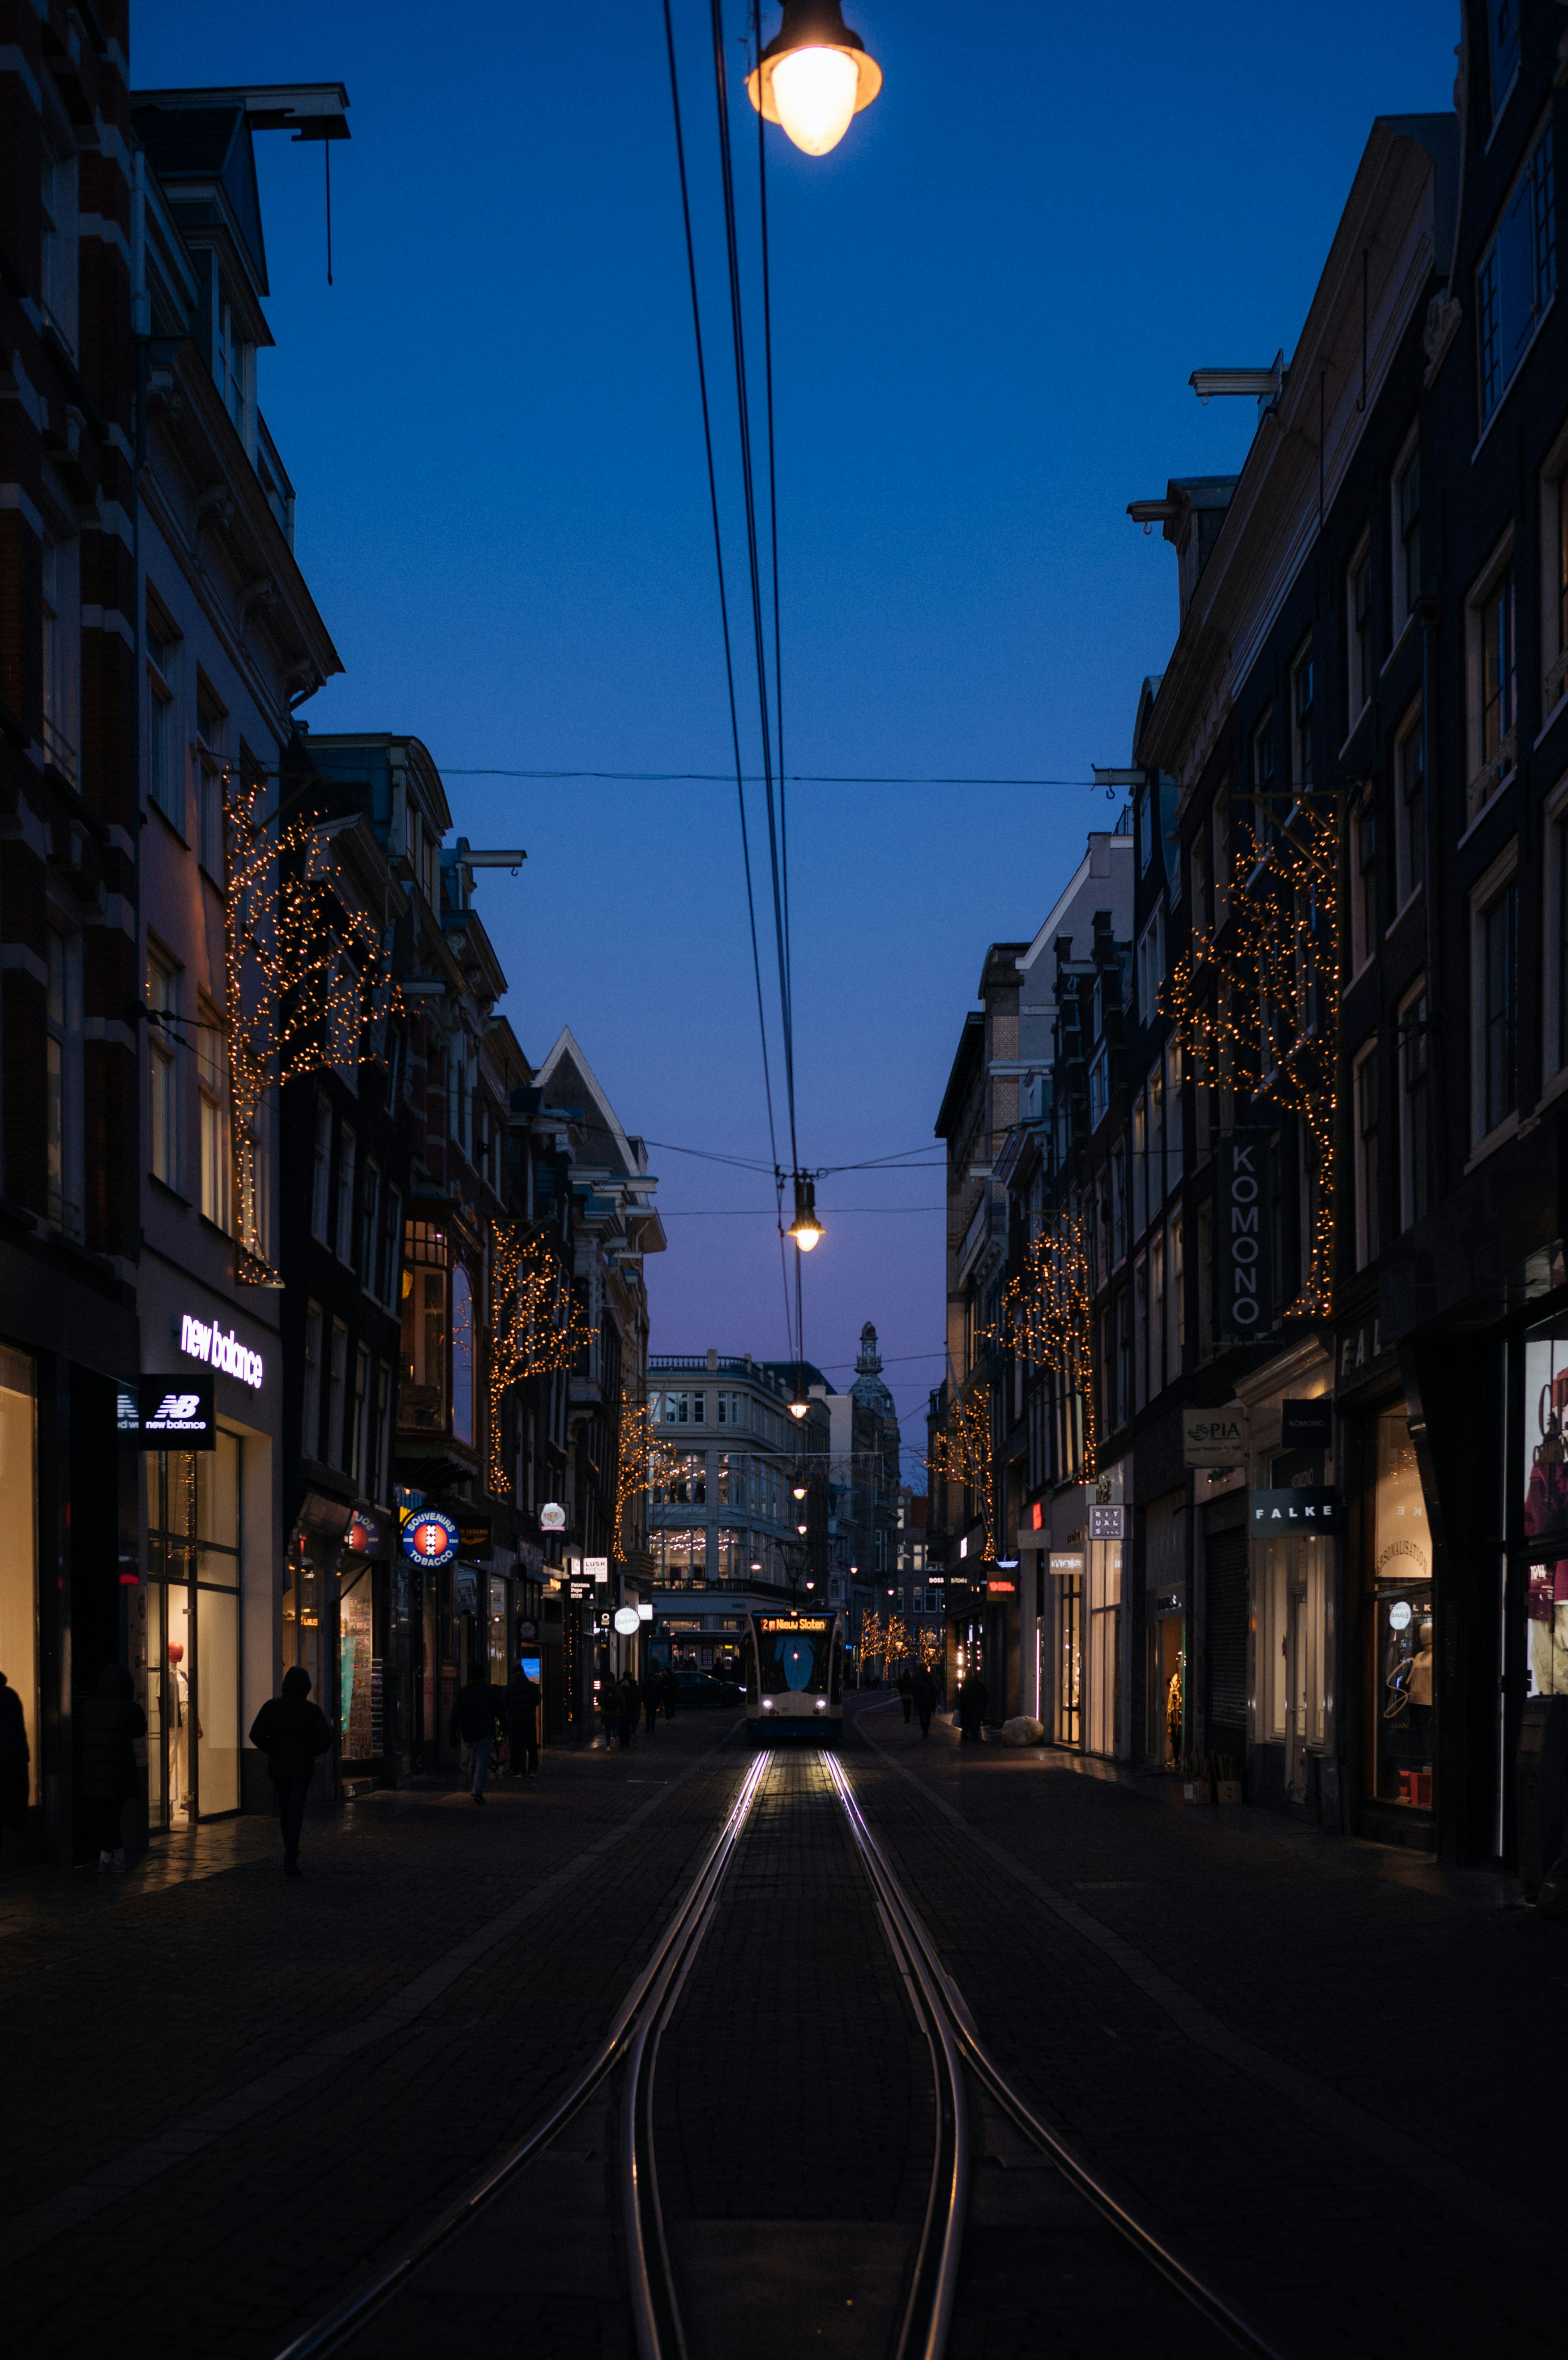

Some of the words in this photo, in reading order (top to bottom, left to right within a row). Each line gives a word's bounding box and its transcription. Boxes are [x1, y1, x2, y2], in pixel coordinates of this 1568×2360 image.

[1231, 1146, 1260, 1325] KOMONO
[181, 1314, 213, 1362] new
[211, 1320, 263, 1389] balance
[166, 1419, 207, 1429] balance
[1211, 1422, 1240, 1437] PIA
[1256, 1505, 1332, 1519] FALKE
[407, 1512, 456, 1533] SOUVENIRS
[410, 1549, 453, 1566] TOBACCO
[762, 1619, 768, 1629] 2
[776, 1618, 799, 1630] Nieuw
[799, 1618, 825, 1629] Sloten
